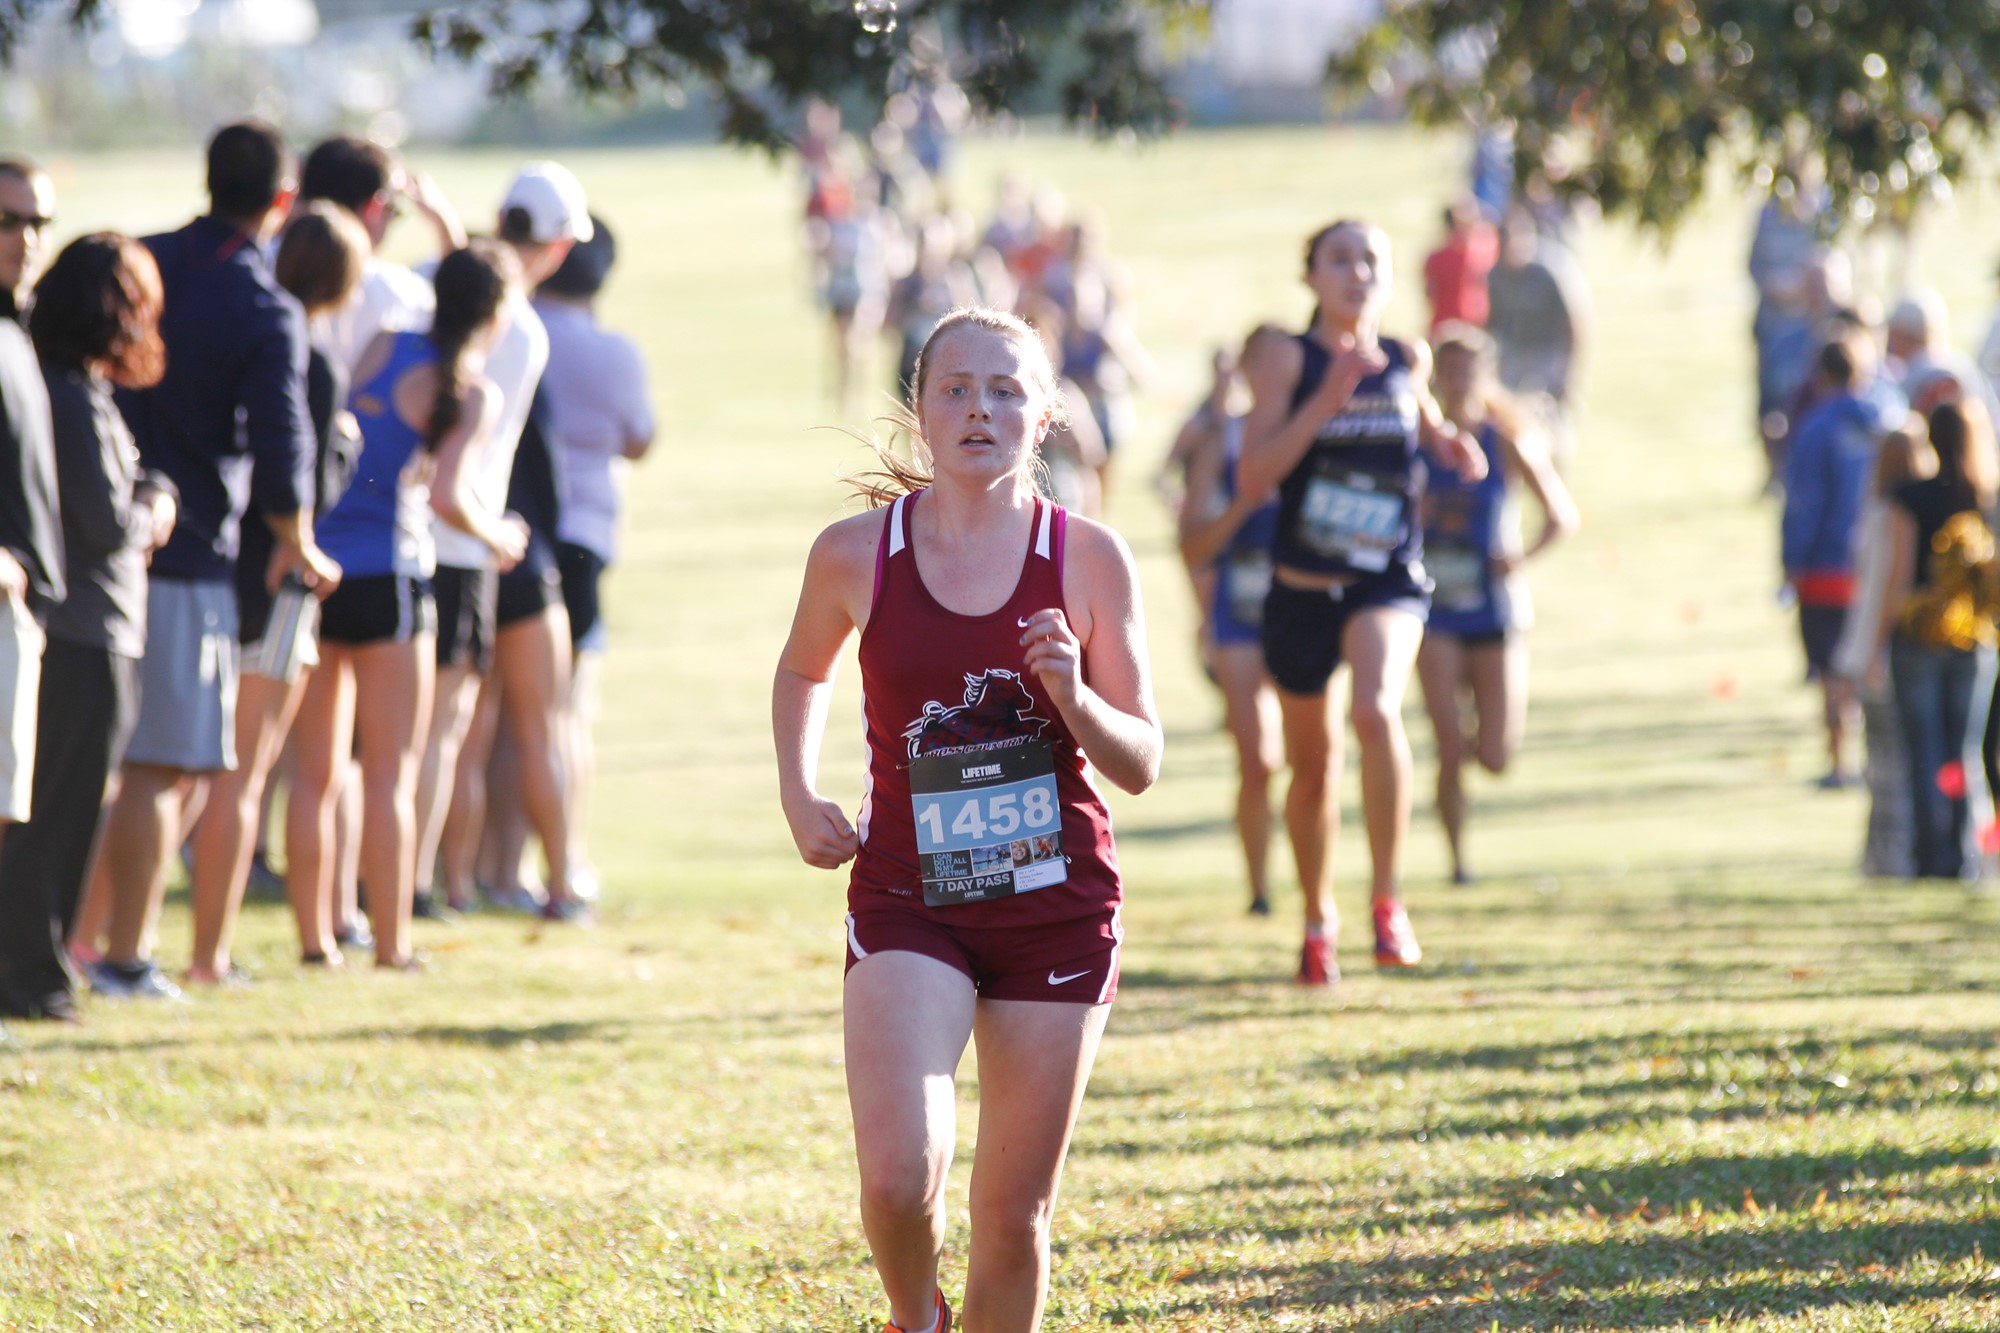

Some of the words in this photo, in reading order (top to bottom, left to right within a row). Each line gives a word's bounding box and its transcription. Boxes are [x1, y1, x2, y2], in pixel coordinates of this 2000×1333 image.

[961, 763, 1002, 779] LIFETIME
[919, 787, 1054, 844] 1458
[937, 882, 944, 893] 7
[947, 879, 974, 893] DAY
[975, 873, 1011, 889] PASS
